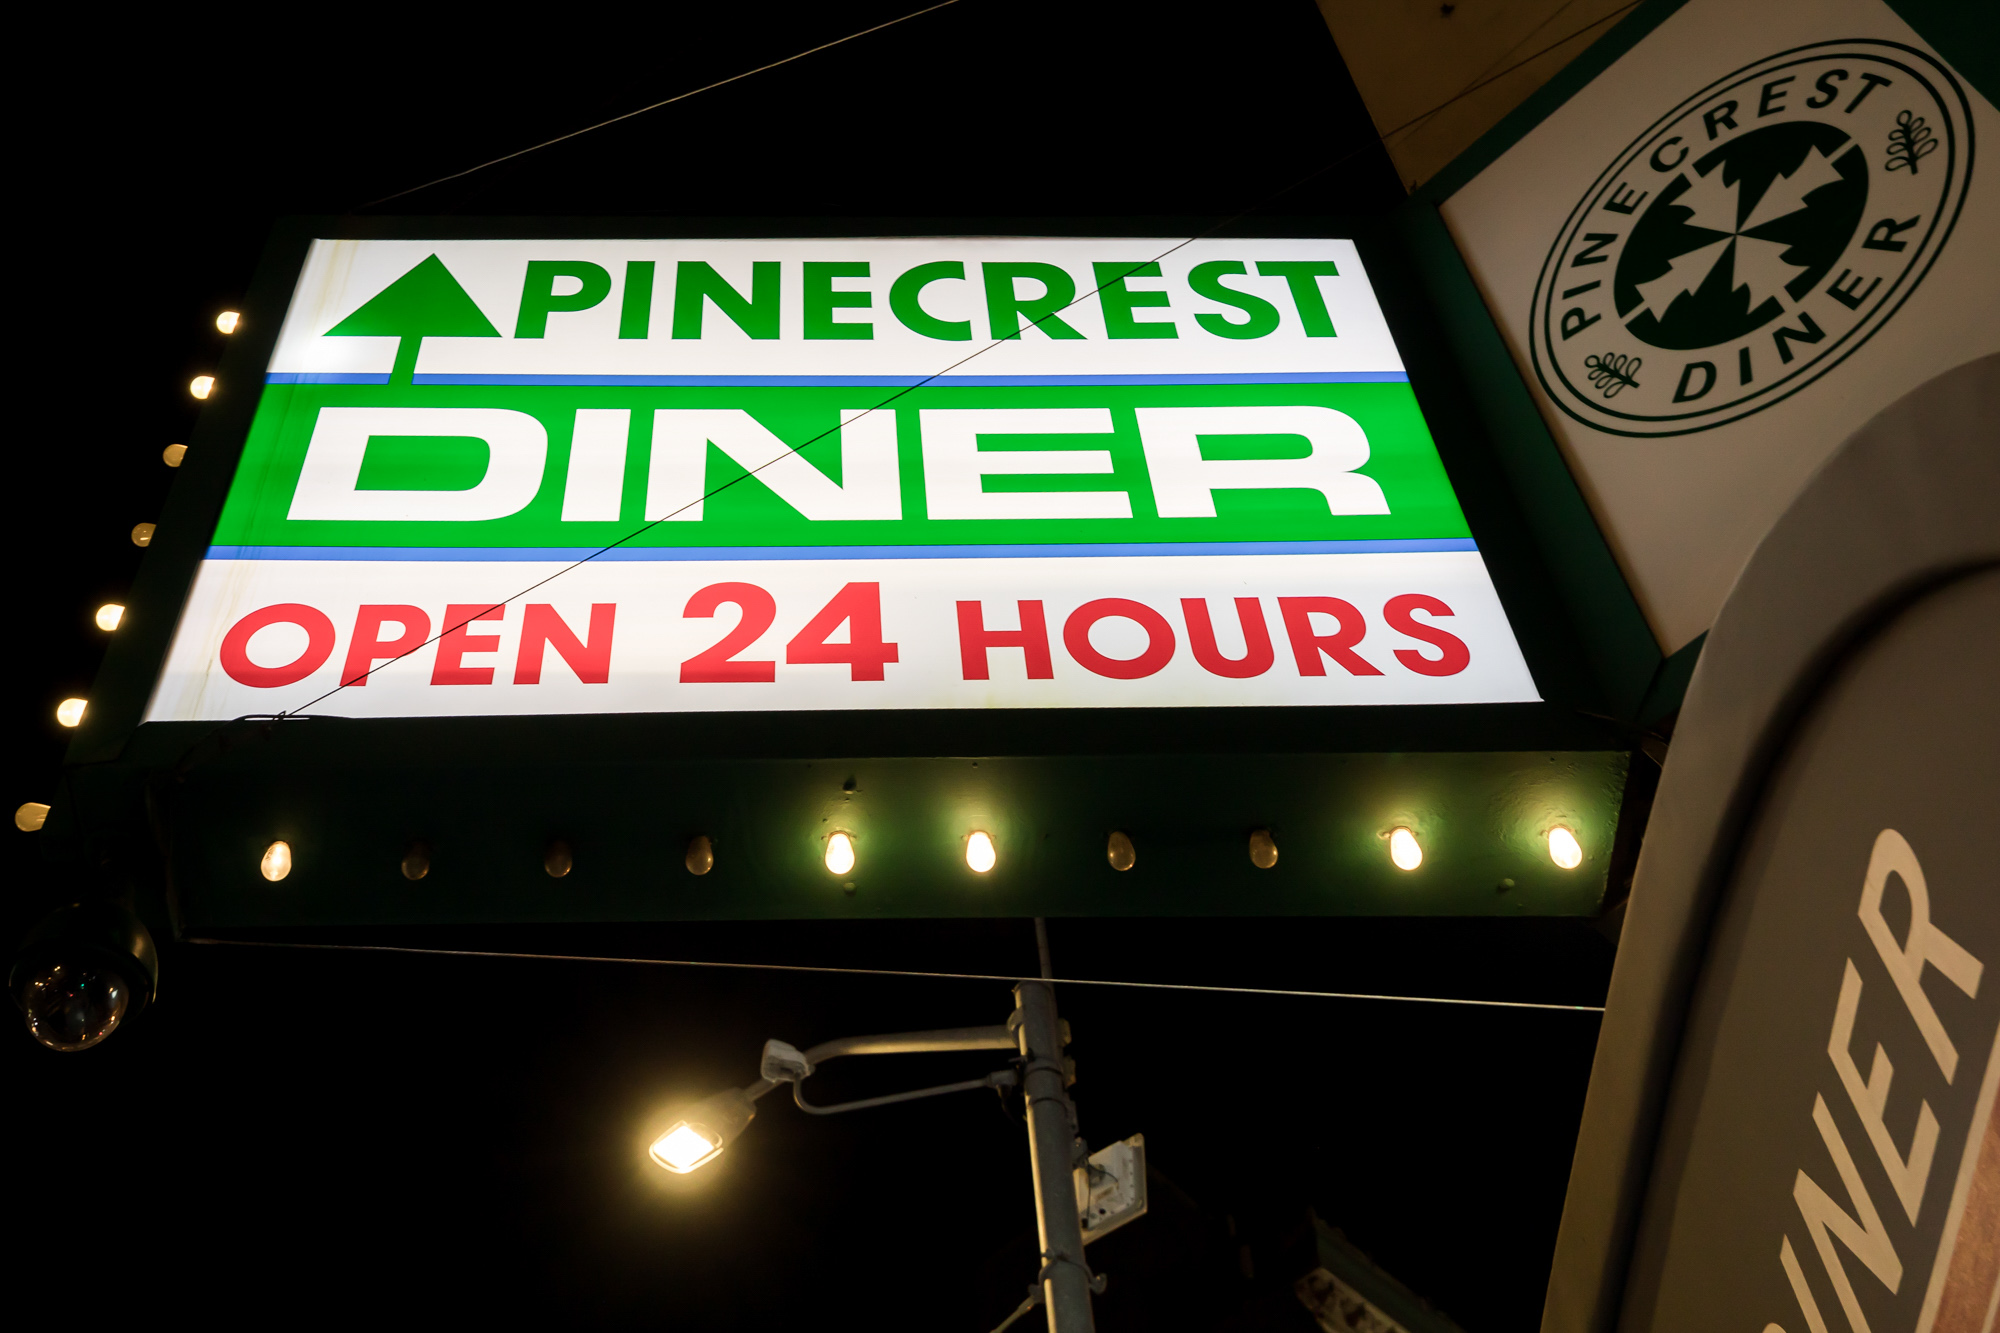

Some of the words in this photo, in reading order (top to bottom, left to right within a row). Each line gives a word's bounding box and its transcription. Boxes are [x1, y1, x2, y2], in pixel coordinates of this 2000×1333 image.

[1560, 68, 1894, 341] PINECREST
[514, 260, 1340, 341] PINECREST
[1672, 214, 1921, 404] DINER
[286, 405, 1392, 522] DINER
[220, 603, 617, 688] OPEN
[679, 581, 899, 683] 24
[956, 593, 1471, 680] HOURS
[1762, 828, 1984, 1333] INER
